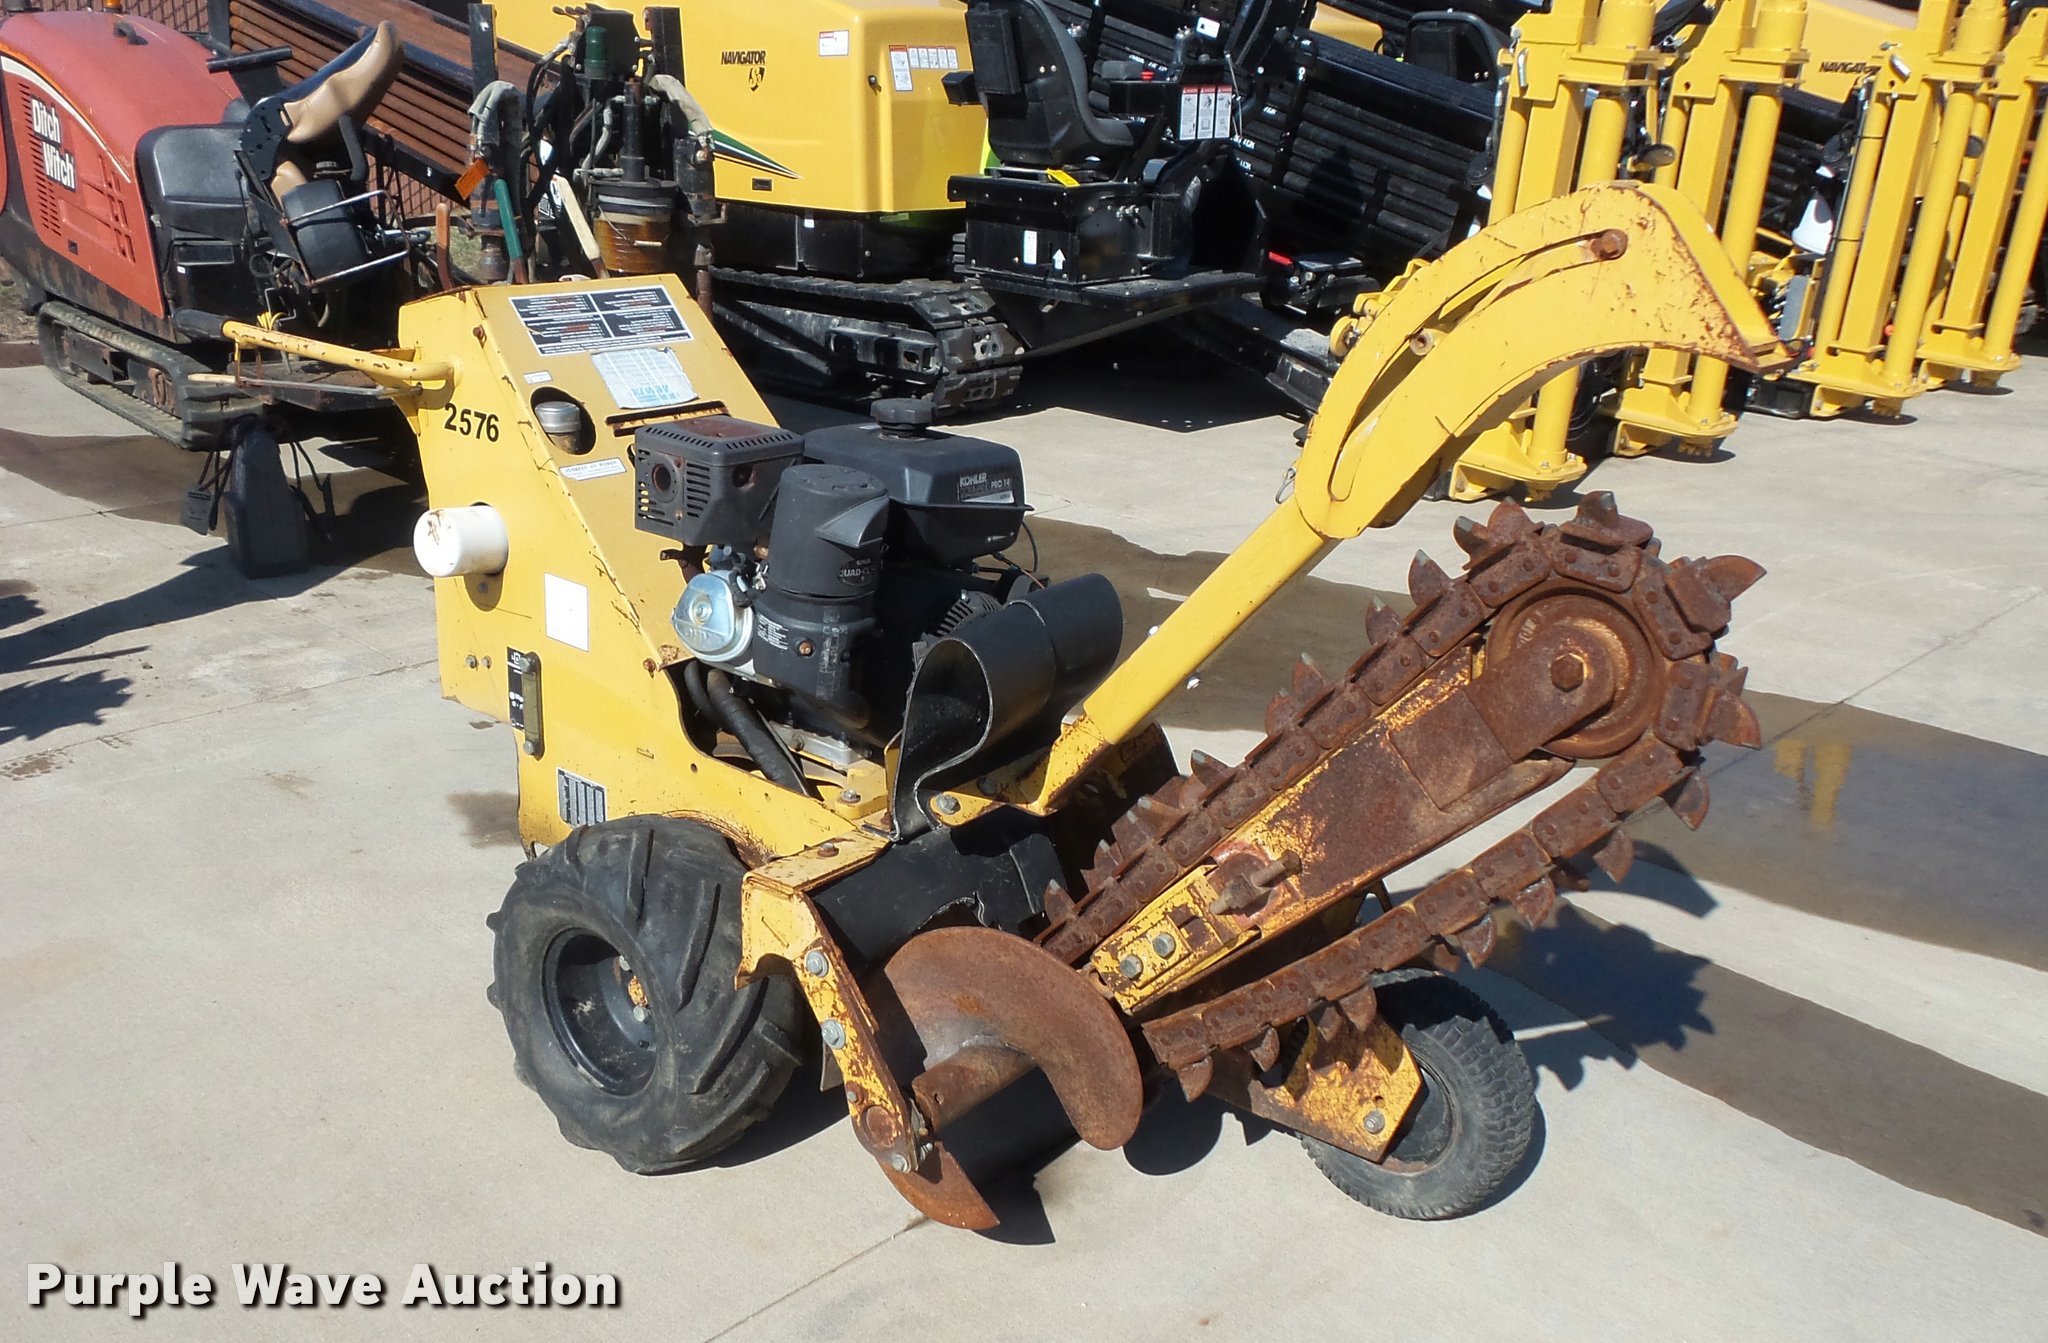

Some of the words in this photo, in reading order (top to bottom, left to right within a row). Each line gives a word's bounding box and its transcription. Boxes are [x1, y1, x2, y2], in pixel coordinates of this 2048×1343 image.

[721, 50, 766, 65] NAVIGATOR
[31, 98, 61, 144] Ditch
[42, 141, 76, 189] Witch
[444, 402, 499, 442] 2576
[960, 472, 987, 488] KOHLER
[991, 479, 1003, 490] PRO
